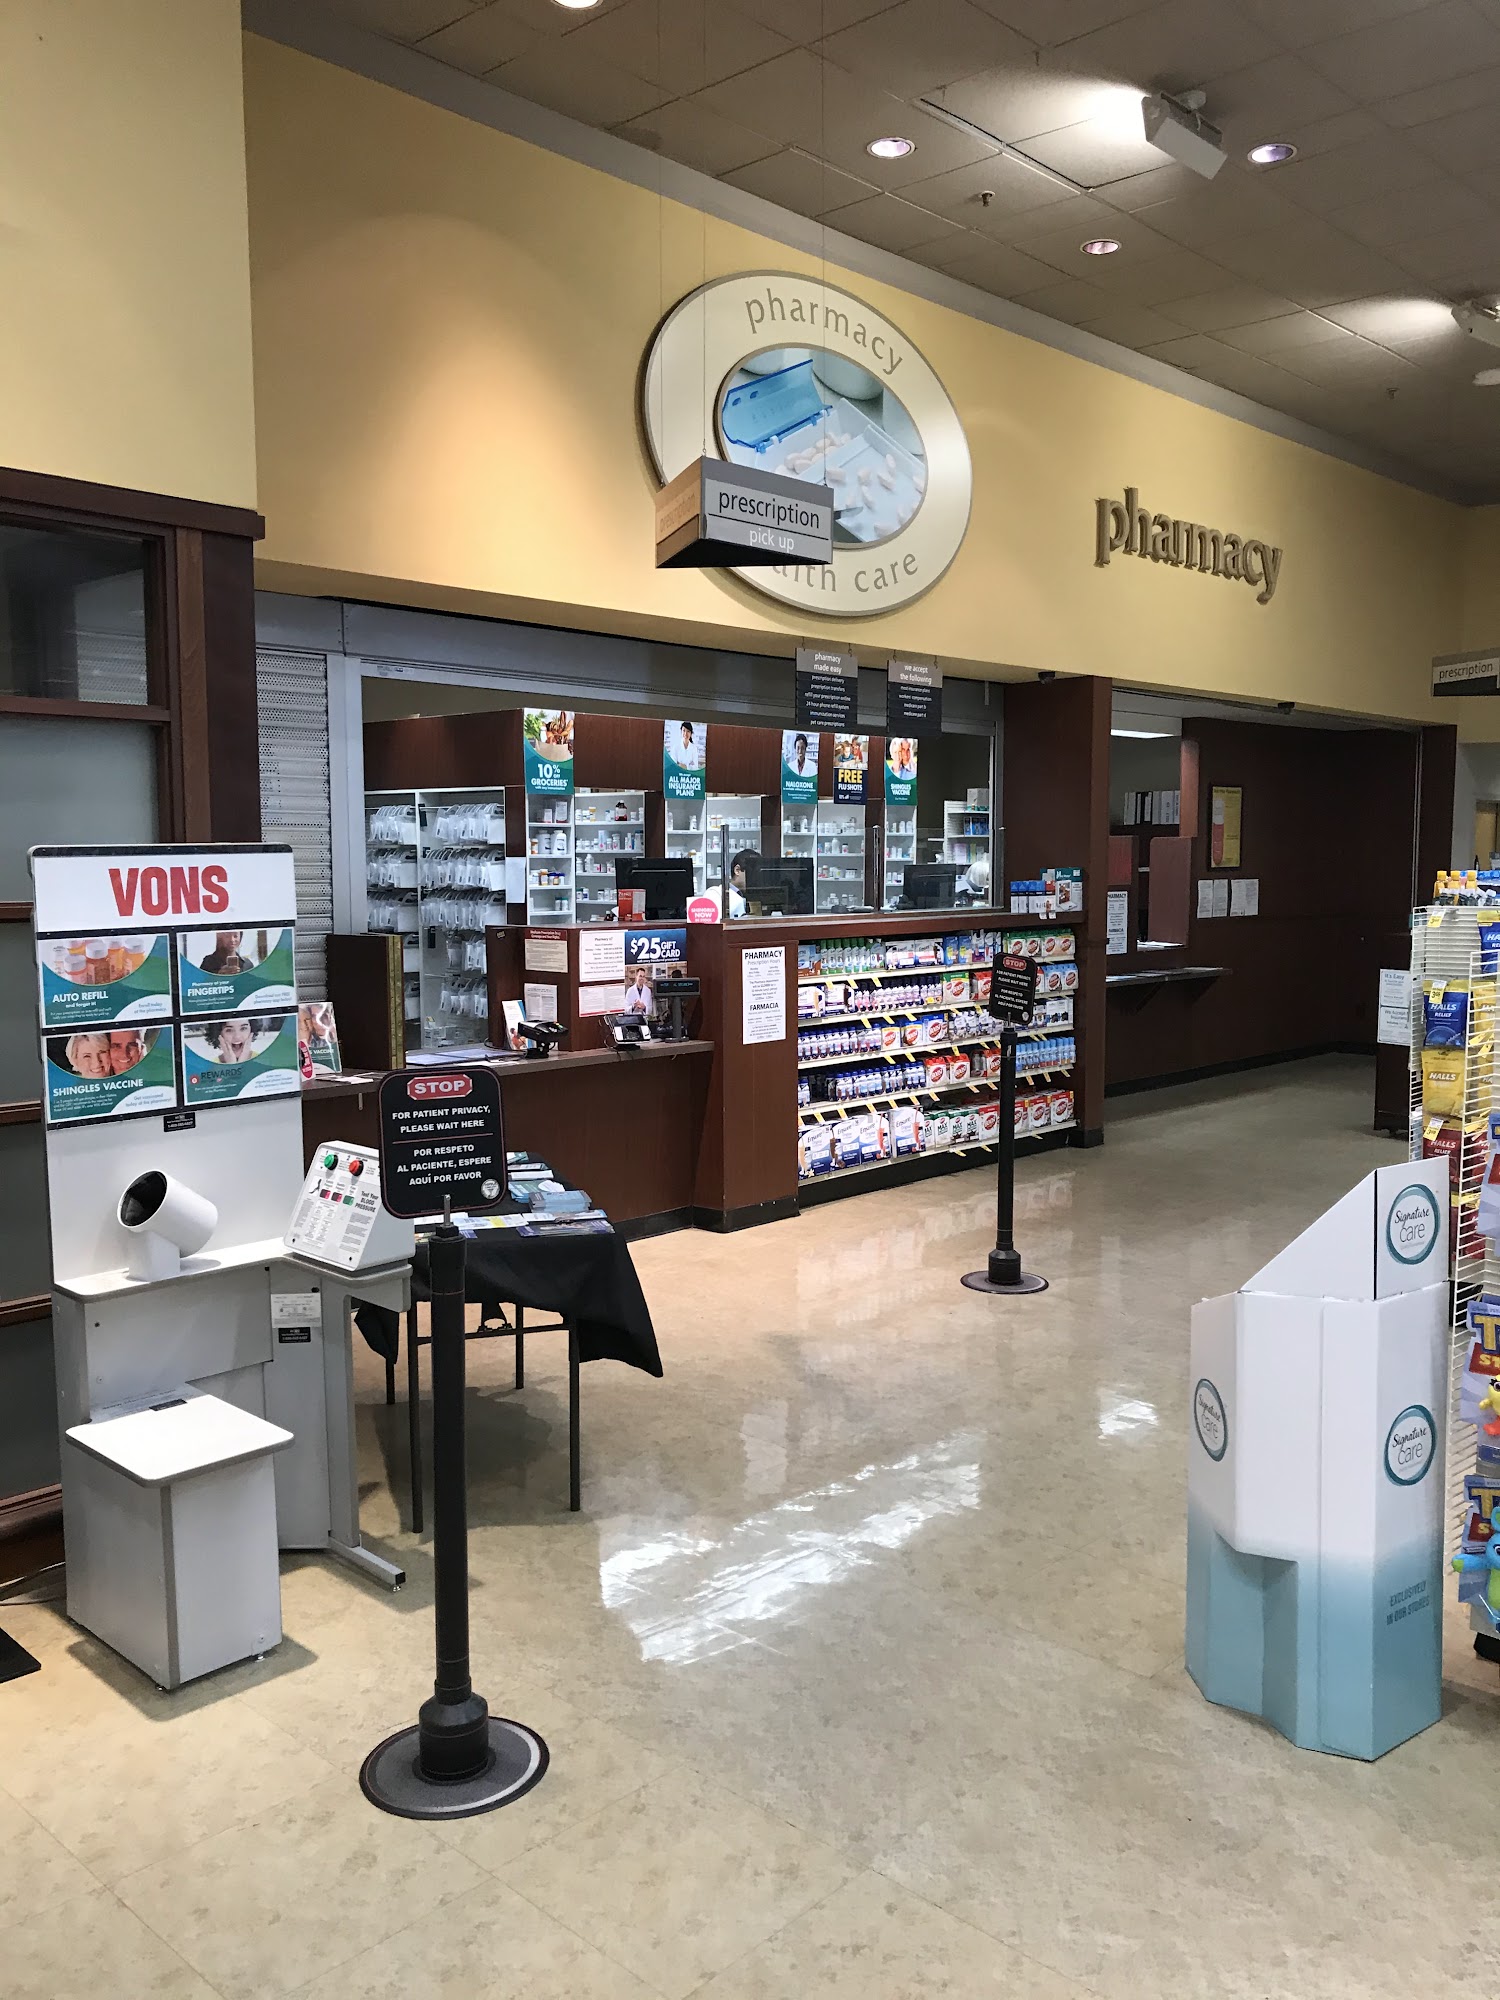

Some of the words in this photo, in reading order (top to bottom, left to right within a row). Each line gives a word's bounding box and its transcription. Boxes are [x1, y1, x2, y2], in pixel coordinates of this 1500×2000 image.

[745, 288, 903, 376] pharmacy
[719, 491, 819, 529] prescription
[750, 528, 775, 547] pick
[779, 536, 795, 553] up
[1094, 486, 1283, 605] pharmacy
[854, 552, 918, 593] care
[814, 653, 841, 664] pharmacy
[814, 664, 830, 672] made
[830, 666, 842, 675] easy
[1439, 662, 1493, 682] prescription
[910, 674, 932, 686] following
[538, 764, 560, 778] 10%
[838, 769, 862, 783] FREE
[108, 864, 230, 917] VONS
[630, 937, 661, 960] $25
[661, 941, 676, 949] GIFT
[661, 949, 680, 958] CARD
[744, 950, 782, 959] PHARMACY
[1005, 959, 1024, 968] STOP
[52, 993, 79, 1003] AUTO
[82, 990, 108, 1000] REFILL
[187, 985, 235, 997] FINGERTIPS
[750, 1002, 779, 1011] FARMACIA
[201, 1068, 241, 1079] REWARDS
[53, 1082, 100, 1097] SHINGLES
[103, 1079, 144, 1090] VACCINE
[415, 1080, 465, 1094] STOP
[413, 1109, 450, 1118] PATIENT
[452, 1105, 490, 1115] PRIVACY,
[400, 1124, 434, 1133] PLEASE
[436, 1122, 459, 1130] WAIT
[461, 1120, 484, 1128] HERE
[896, 1116, 910, 1127] Ensure
[938, 1122, 947, 1131] MAX
[953, 1123, 962, 1132] MAX
[967, 1120, 977, 1130] MAX
[860, 1123, 875, 1134] Ensure
[807, 1132, 822, 1142] Ensure
[414, 1148, 432, 1157] POR
[435, 1144, 474, 1155] RESPETO
[1431, 1140, 1456, 1148] HALLS
[411, 1160, 457, 1172] PACIENTE,
[458, 1156, 491, 1167] ESPERE
[409, 1173, 431, 1186] AQUÍ
[434, 1175, 451, 1183] POR
[454, 1171, 481, 1180] FAVOR
[355, 1203, 377, 1213] PRESSURE
[1394, 1206, 1430, 1228] Signature
[1400, 1223, 1425, 1242] care
[1199, 1394, 1220, 1422] Signature
[1392, 1427, 1427, 1448] Signature
[1398, 1443, 1423, 1464] care
[1408, 1595, 1429, 1615] STORES
